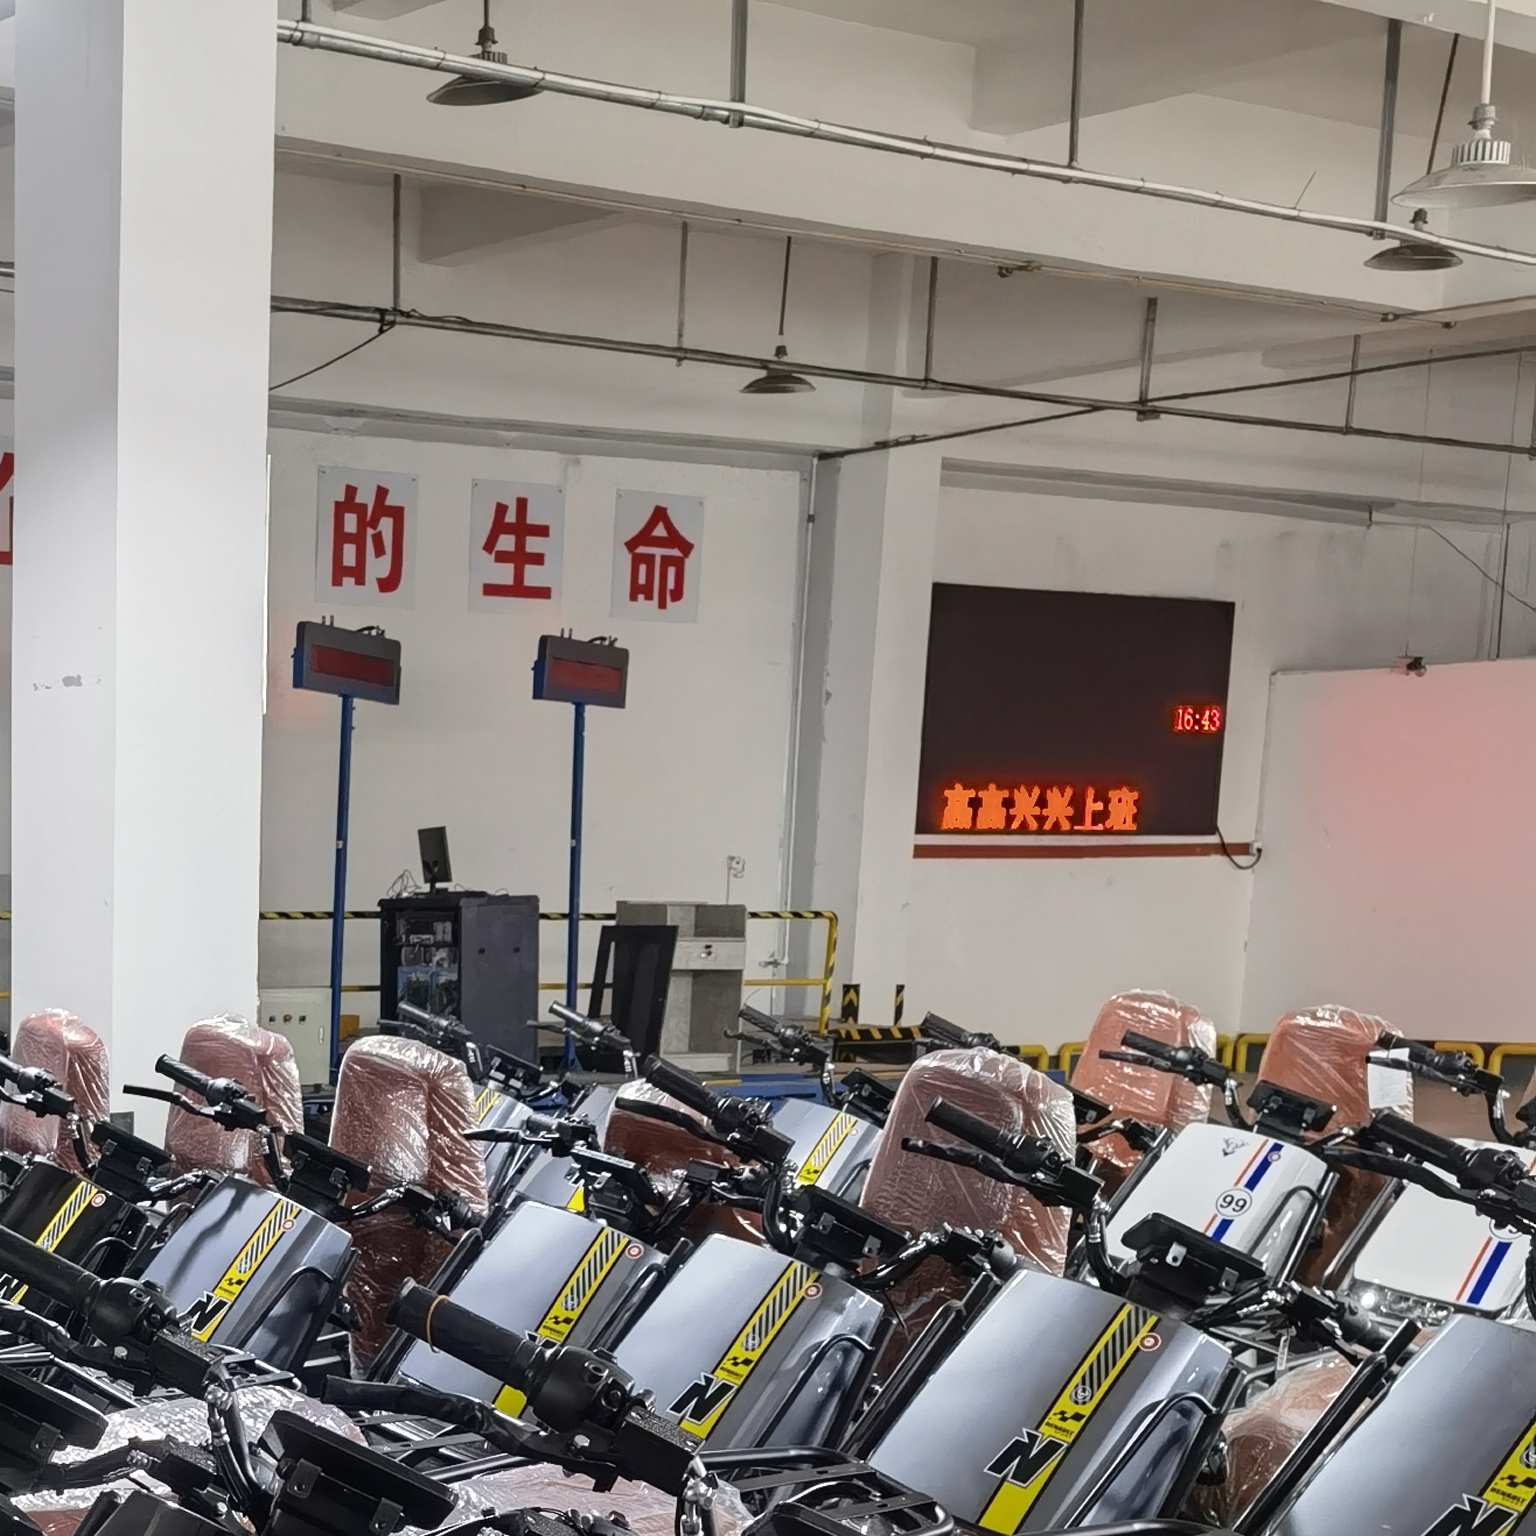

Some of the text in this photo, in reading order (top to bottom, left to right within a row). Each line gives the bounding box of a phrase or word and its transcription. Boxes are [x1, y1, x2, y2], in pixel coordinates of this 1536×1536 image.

[330, 483, 695, 611] 的生命
[1174, 707, 1221, 732] 16:43
[940, 782, 1139, 831] 高高兴兴上班
[1219, 1193, 1248, 1213] 99
[665, 1372, 737, 1424] N
[983, 1427, 1069, 1488] N
